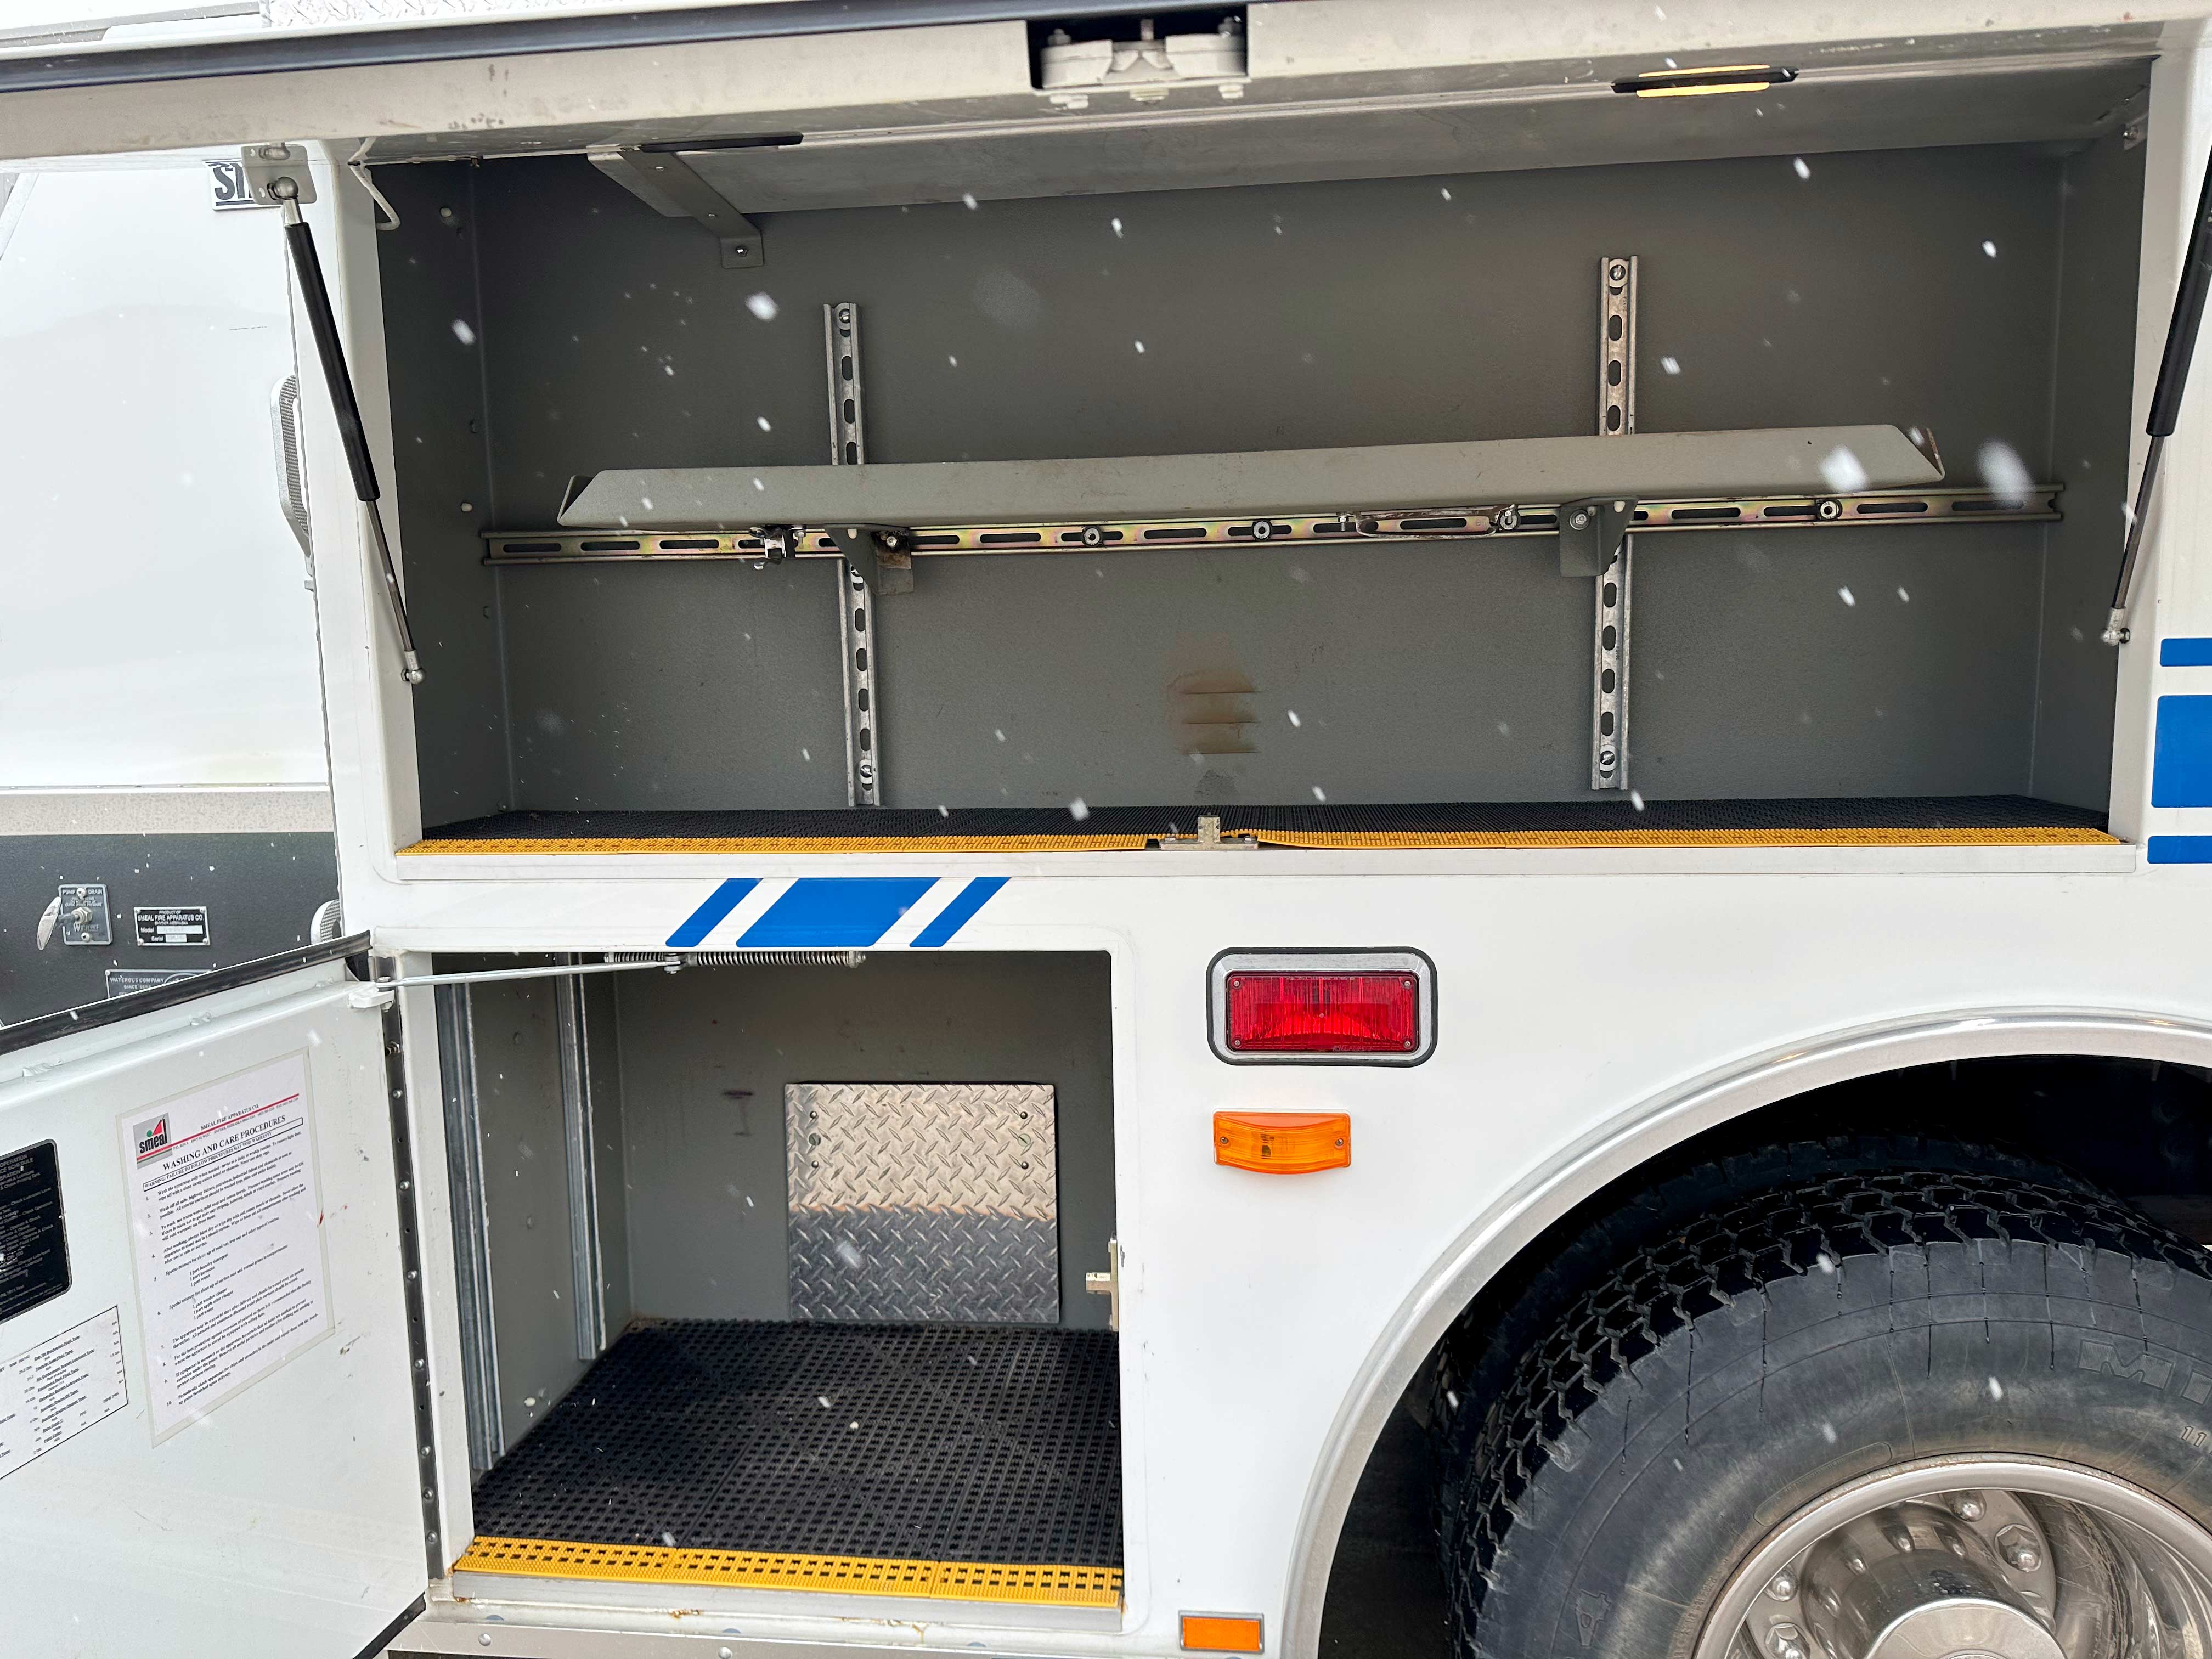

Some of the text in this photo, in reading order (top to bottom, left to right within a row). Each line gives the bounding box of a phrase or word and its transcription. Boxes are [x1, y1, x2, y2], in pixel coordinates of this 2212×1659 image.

[139, 1118, 168, 1154] smeal
[201, 1120, 215, 1130] SMEAL
[217, 1116, 227, 1124] FIRE
[228, 1106, 251, 1119] APPARATUS
[163, 1114, 285, 1171] WASHING AND CARE PROCEDURES
[166, 1167, 184, 1179] FAILURE
[190, 1158, 207, 1169] FOLLOW
[208, 1147, 233, 1161] PROCEDURES
[251, 1130, 271, 1142] WARRANTY
